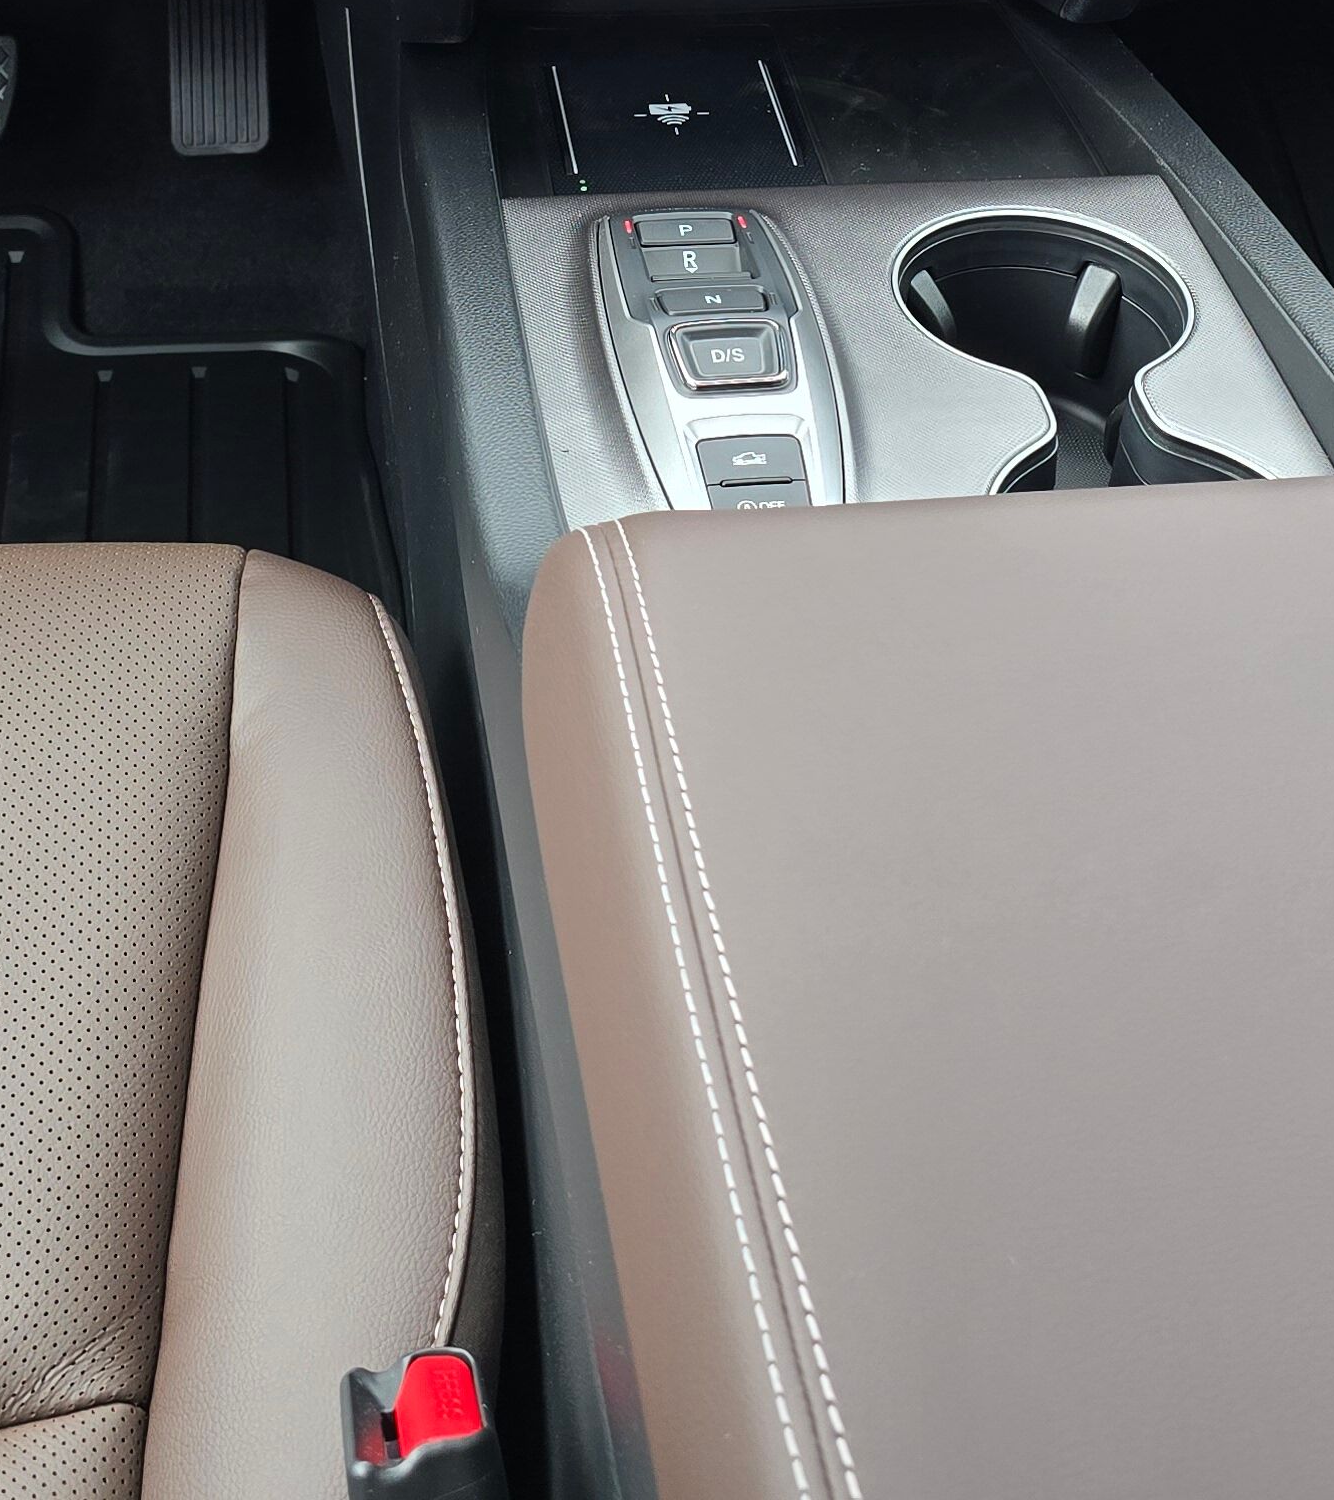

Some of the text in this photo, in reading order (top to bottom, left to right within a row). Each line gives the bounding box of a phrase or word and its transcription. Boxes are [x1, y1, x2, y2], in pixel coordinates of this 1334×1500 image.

[679, 224, 693, 237] P
[683, 251, 696, 270] R
[704, 295, 722, 304] N
[711, 348, 745, 364] D/S
